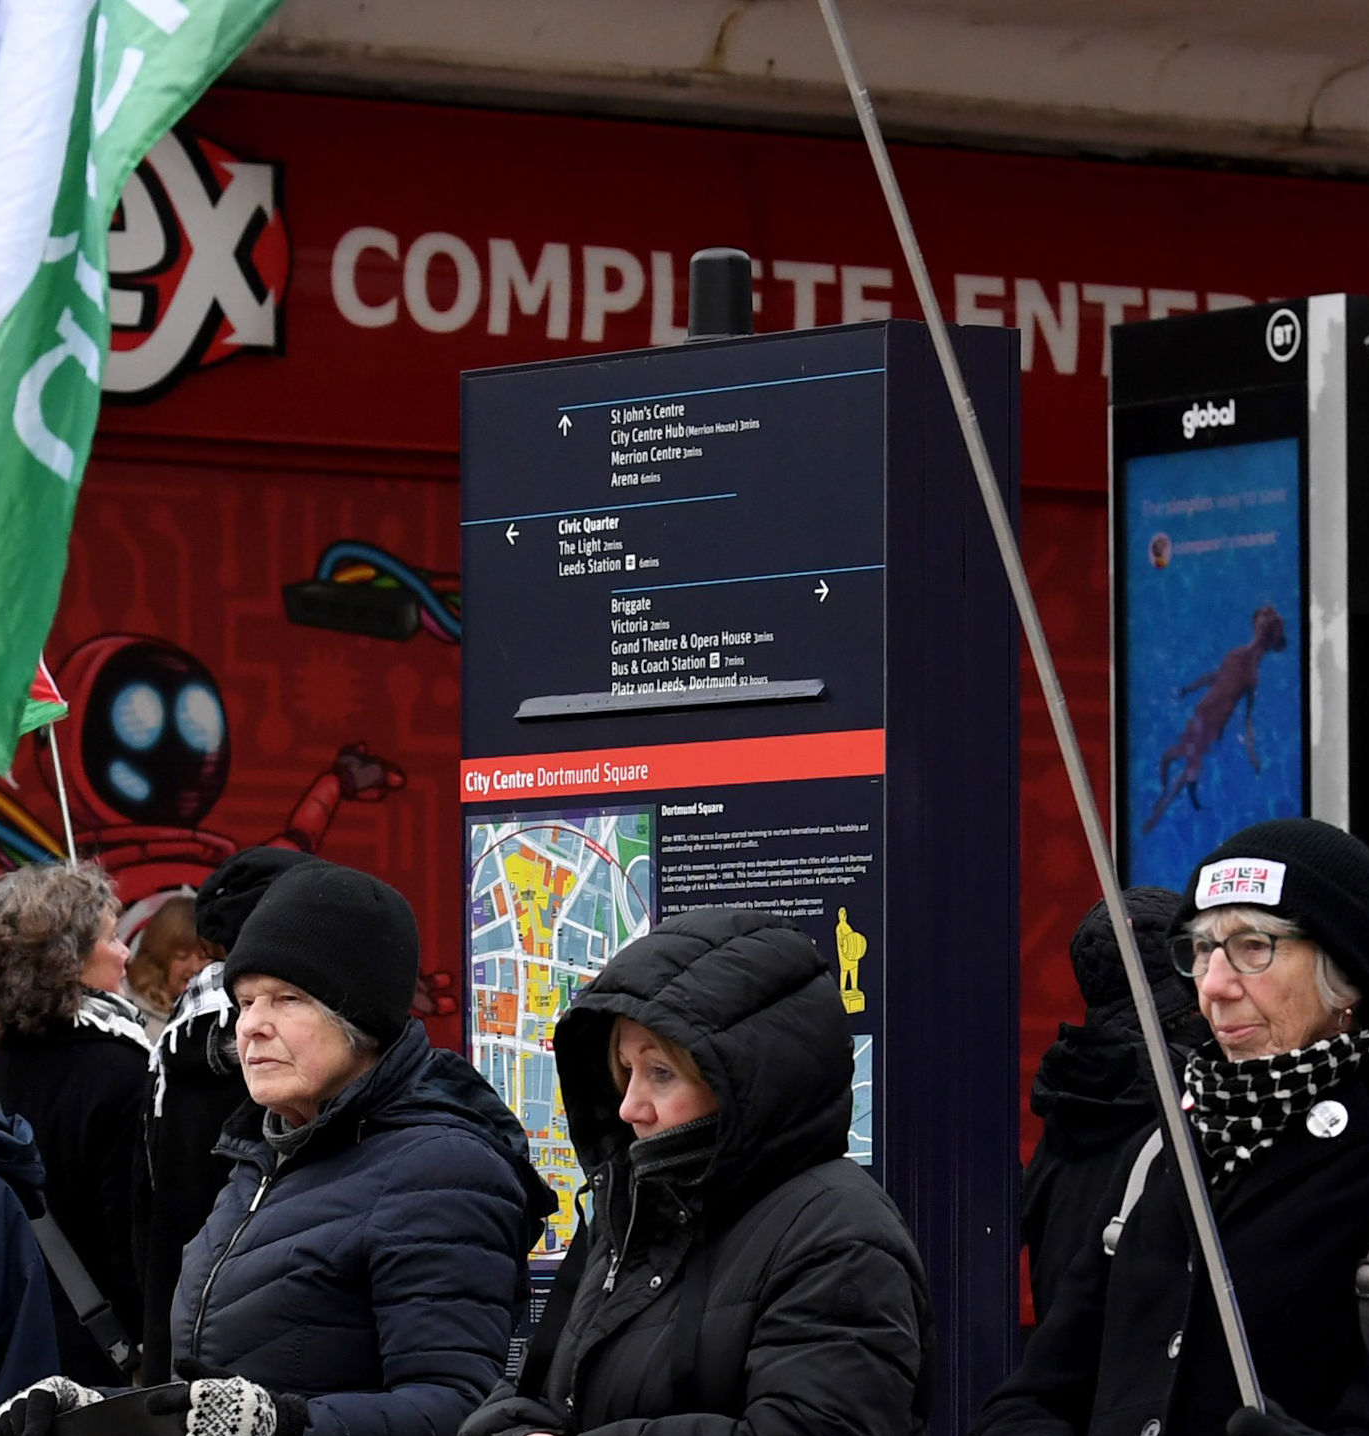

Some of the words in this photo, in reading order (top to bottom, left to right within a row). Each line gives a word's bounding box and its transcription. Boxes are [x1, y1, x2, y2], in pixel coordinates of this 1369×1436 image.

[331, 226, 893, 346] COMPLTE
[1273, 323, 1295, 347] BT
[611, 409, 621, 424] St
[623, 406, 652, 425] John's
[653, 403, 685, 420] Centre
[1182, 398, 1236, 440] global
[611, 430, 630, 447] City
[632, 426, 663, 444] Centre
[665, 423, 685, 439] Hub
[739, 418, 760, 432] 3mins
[611, 450, 649, 466] Merrion
[650, 446, 682, 463] Centre
[682, 446, 703, 459] 3mins
[611, 472, 639, 488] Arena
[558, 518, 582, 535] Civic
[583, 515, 620, 535] Quarter
[559, 540, 577, 556] The
[578, 537, 602, 557] Light
[559, 560, 586, 577] Leeds
[587, 557, 622, 574] Station
[611, 597, 652, 616] Briggate
[611, 617, 649, 635] Victoria
[611, 638, 640, 656] Grand
[642, 636, 679, 653] Theatre
[679, 634, 688, 650] &
[690, 633, 720, 652] Opera
[721, 630, 752, 646] House
[611, 661, 629, 677] Bus
[631, 659, 639, 675] &
[640, 656, 670, 674] Coach
[672, 654, 706, 672] Station
[611, 682, 635, 697] Platz
[637, 682, 655, 695] von
[656, 676, 688, 694] Leeds,
[689, 672, 737, 691] Dortmund
[465, 770, 491, 796] City
[493, 769, 535, 791] Centre
[537, 762, 600, 788] Dortmund
[603, 762, 649, 787] Square
[661, 803, 697, 816] Dortmund
[698, 802, 724, 816] Square
